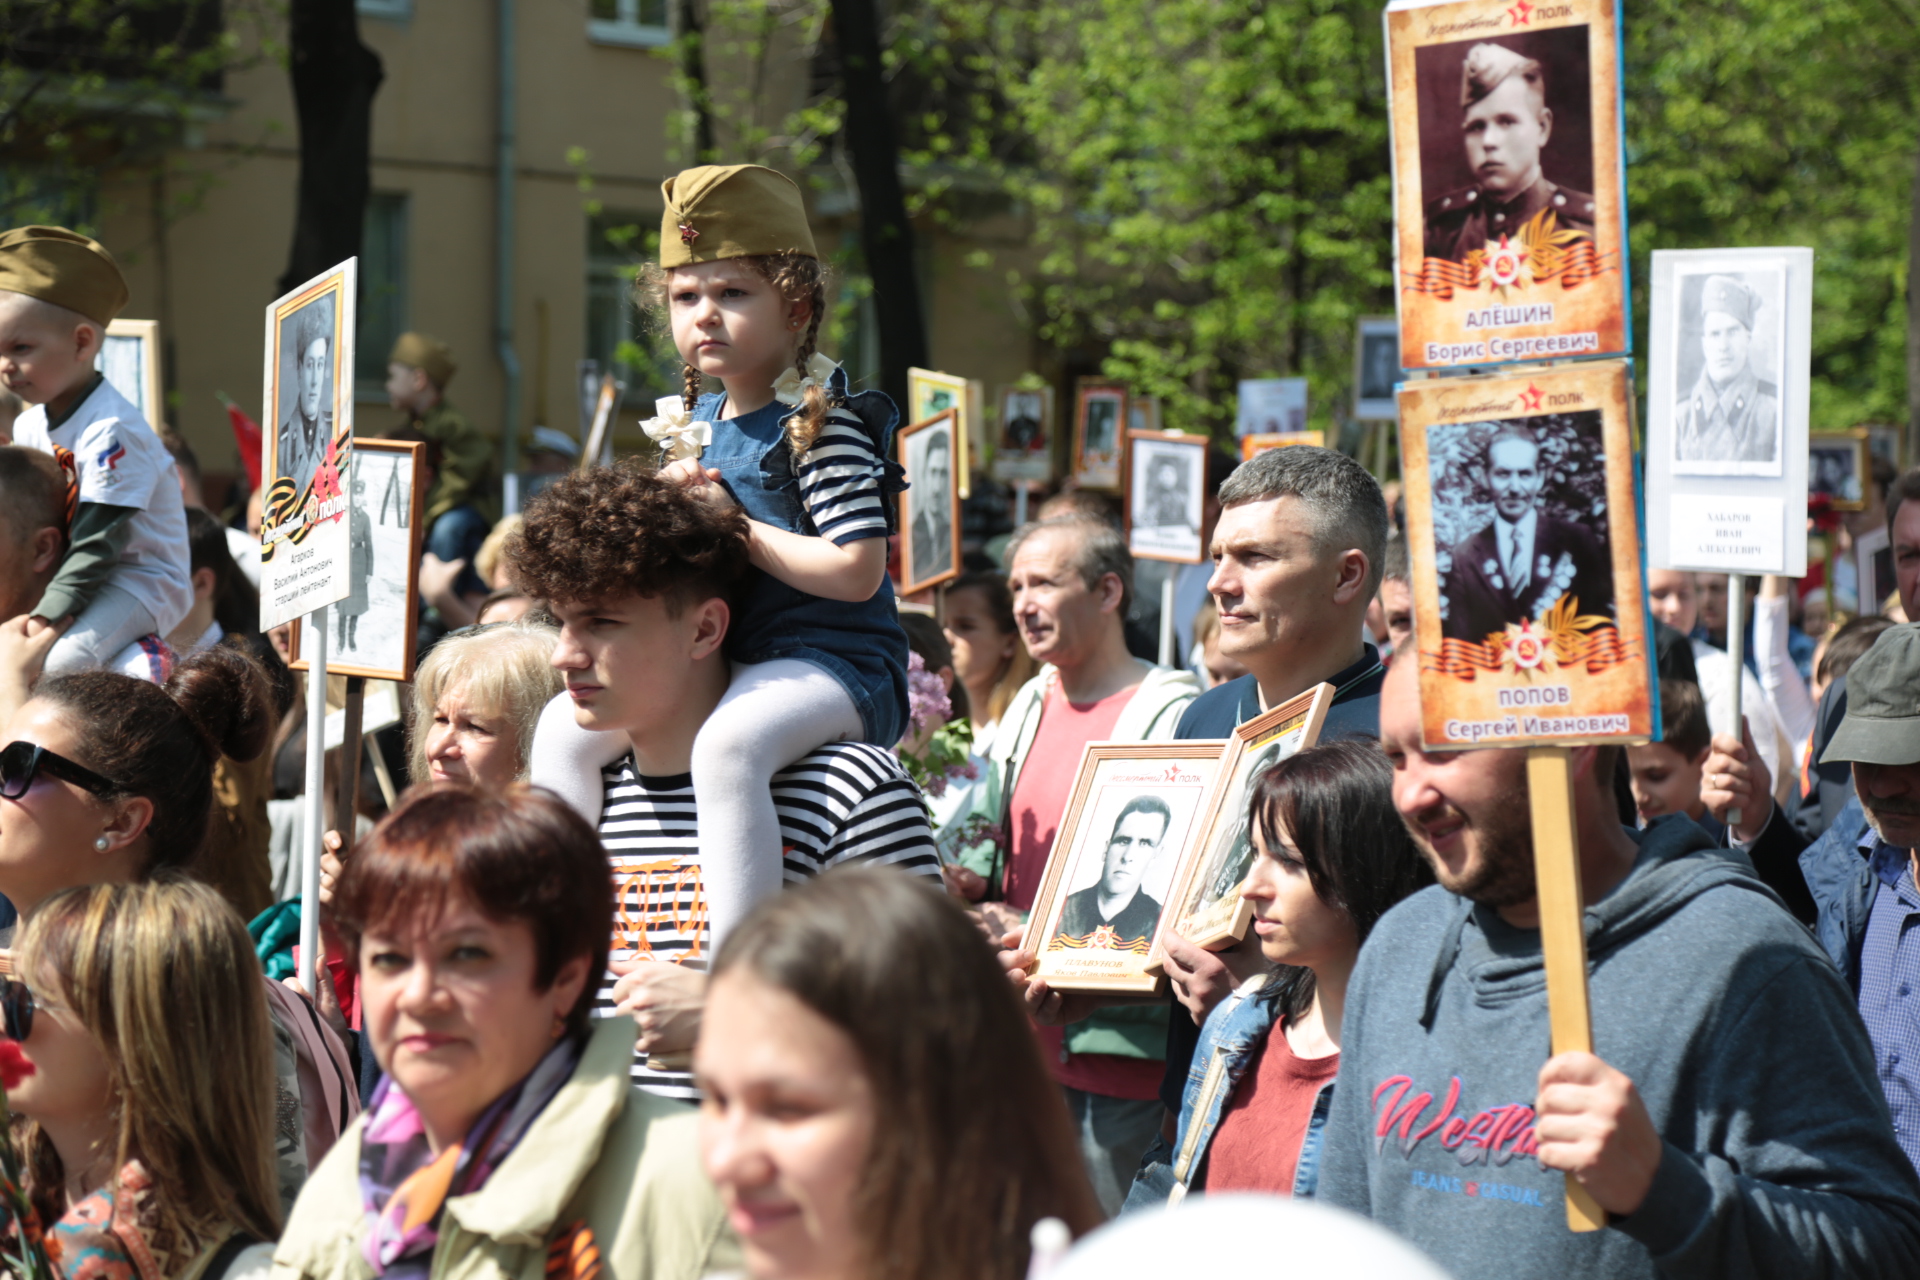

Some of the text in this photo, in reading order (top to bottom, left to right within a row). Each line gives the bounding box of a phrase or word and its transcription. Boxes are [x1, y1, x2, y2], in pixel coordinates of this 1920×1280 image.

[1465, 303, 1553, 329] АЛЁШИН
[1427, 333, 1597, 362] Борис Сергеевич
[319, 494, 346, 520] ПОЛК
[1707, 512, 1751, 523] ХАБАРОВ
[1715, 529, 1742, 538] ИВАН
[290, 548, 315, 566] Агарков
[1698, 544, 1761, 555] АЛЕКСЕЕВИЧ
[273, 558, 333, 591] Василий Антонович
[275, 575, 332, 608] старший лейтенант
[1499, 687, 1570, 706] ПОПОВ
[1447, 714, 1628, 741] Сергей Иванович
[1053, 969, 1077, 977] Яков
[1064, 958, 1124, 968] ПЛАВУНОВ
[1371, 1074, 1542, 1168] Westla
[1411, 1169, 1462, 1194] JEANS
[1480, 1182, 1546, 1208] CASUAL
